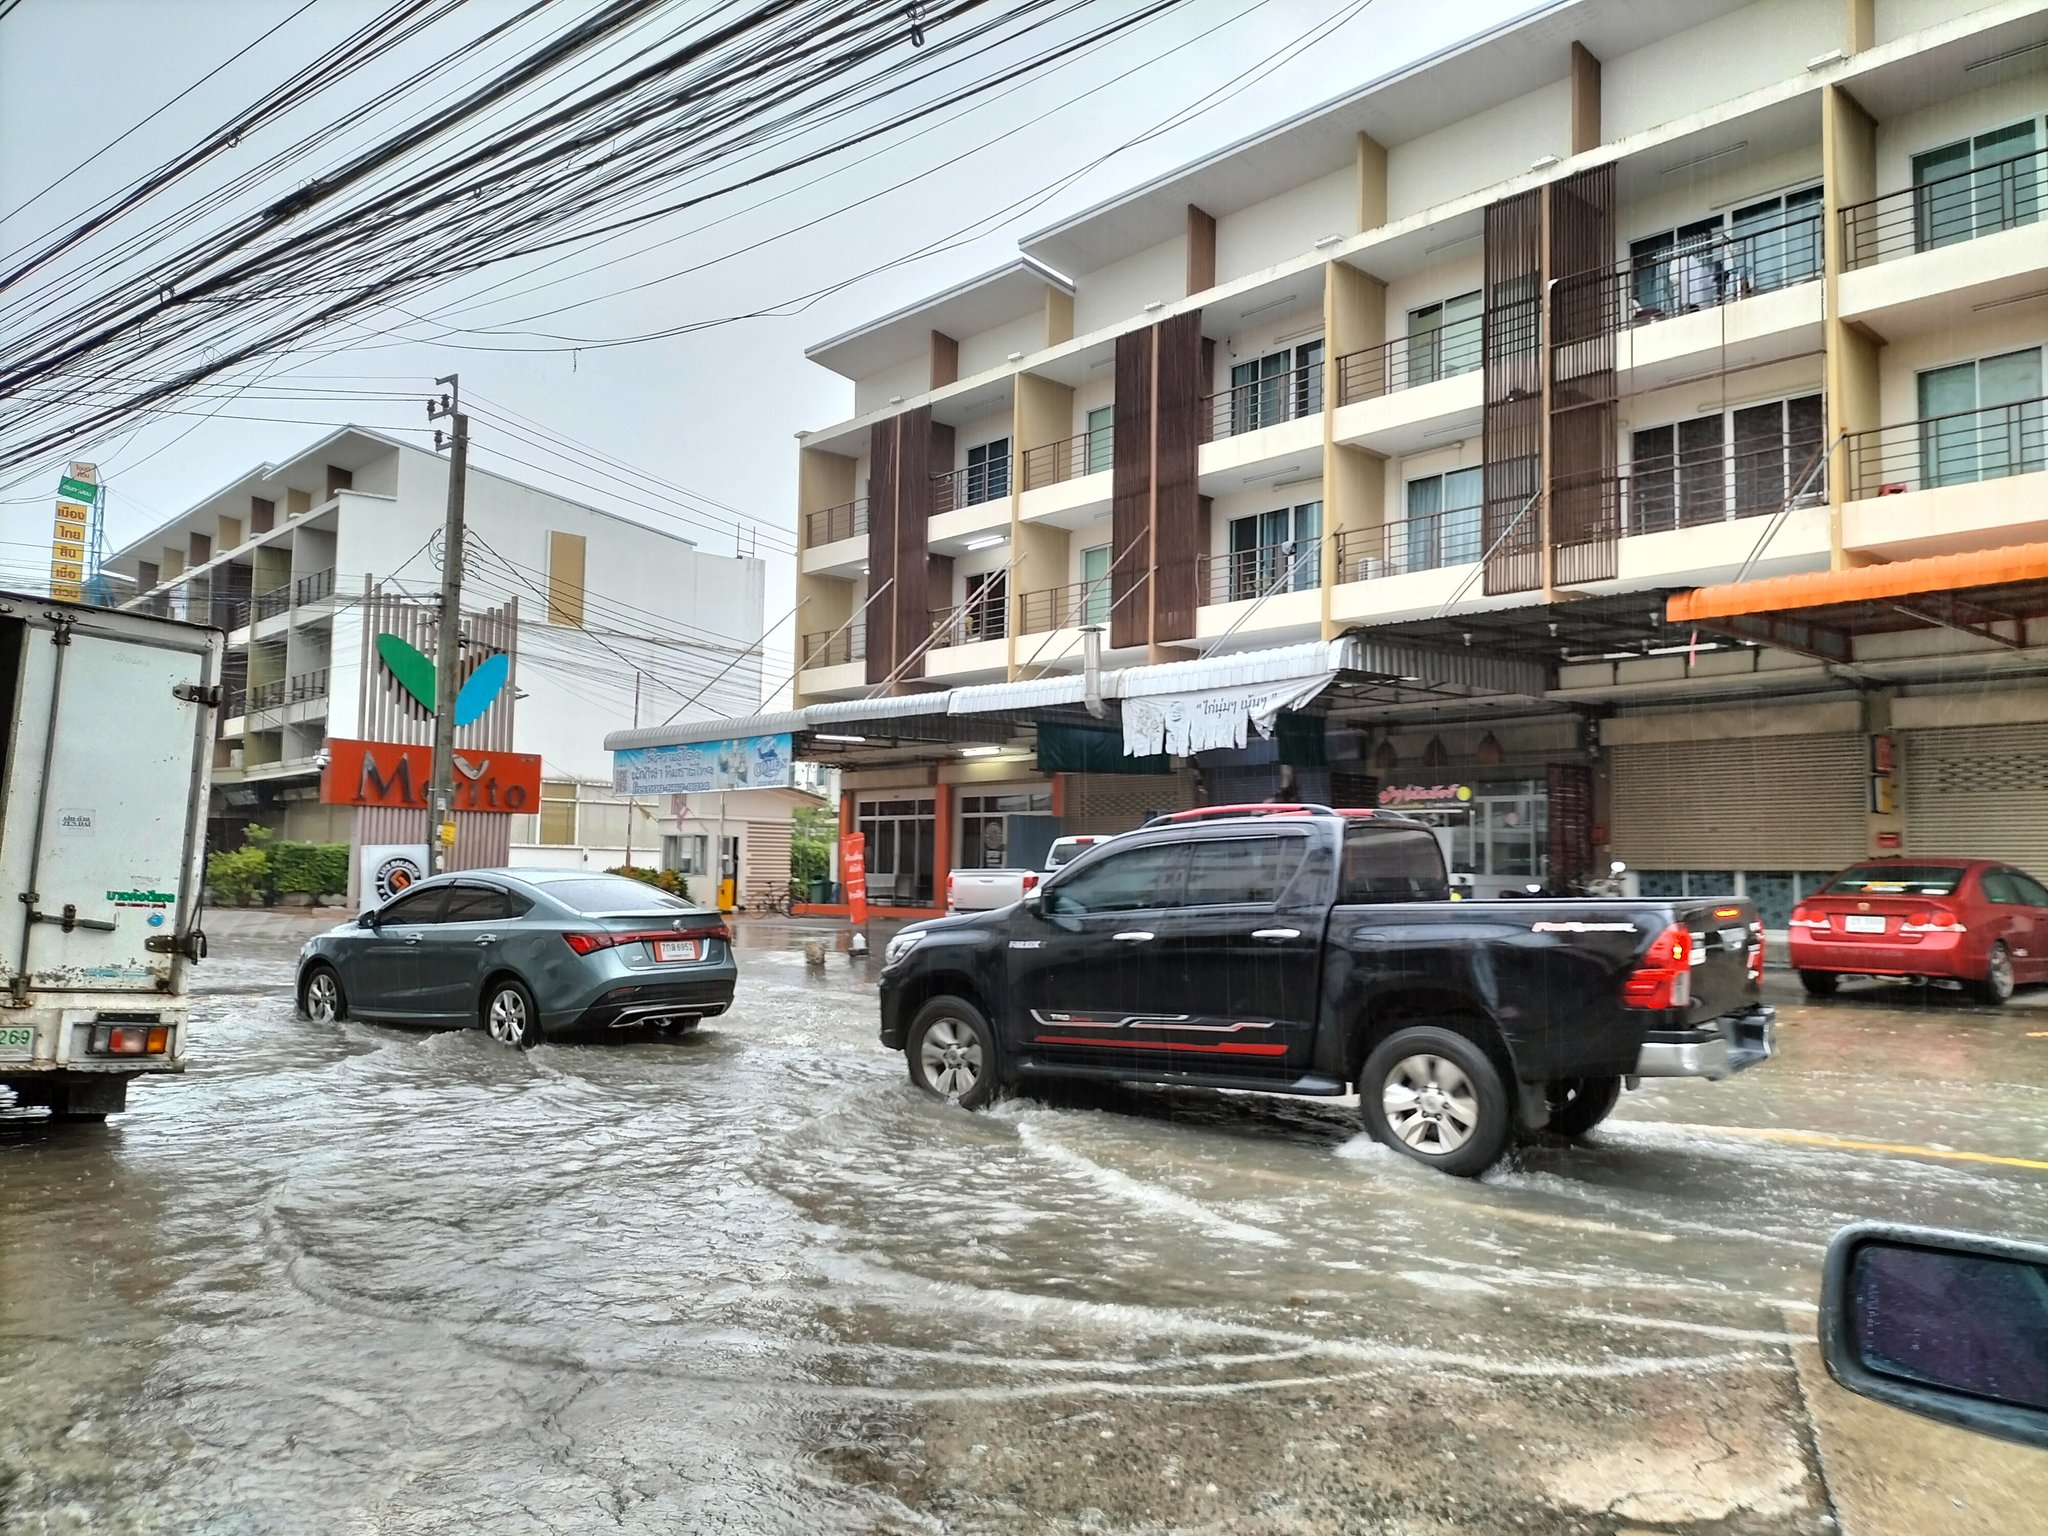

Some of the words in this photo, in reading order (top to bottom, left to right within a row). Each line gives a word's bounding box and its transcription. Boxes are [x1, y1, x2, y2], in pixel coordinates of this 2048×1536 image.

[59, 525, 81, 540] ไทย
[60, 545, 76, 558] สิน
[56, 564, 76, 579] เชื่อ
[0, 1030, 30, 1045] 269
